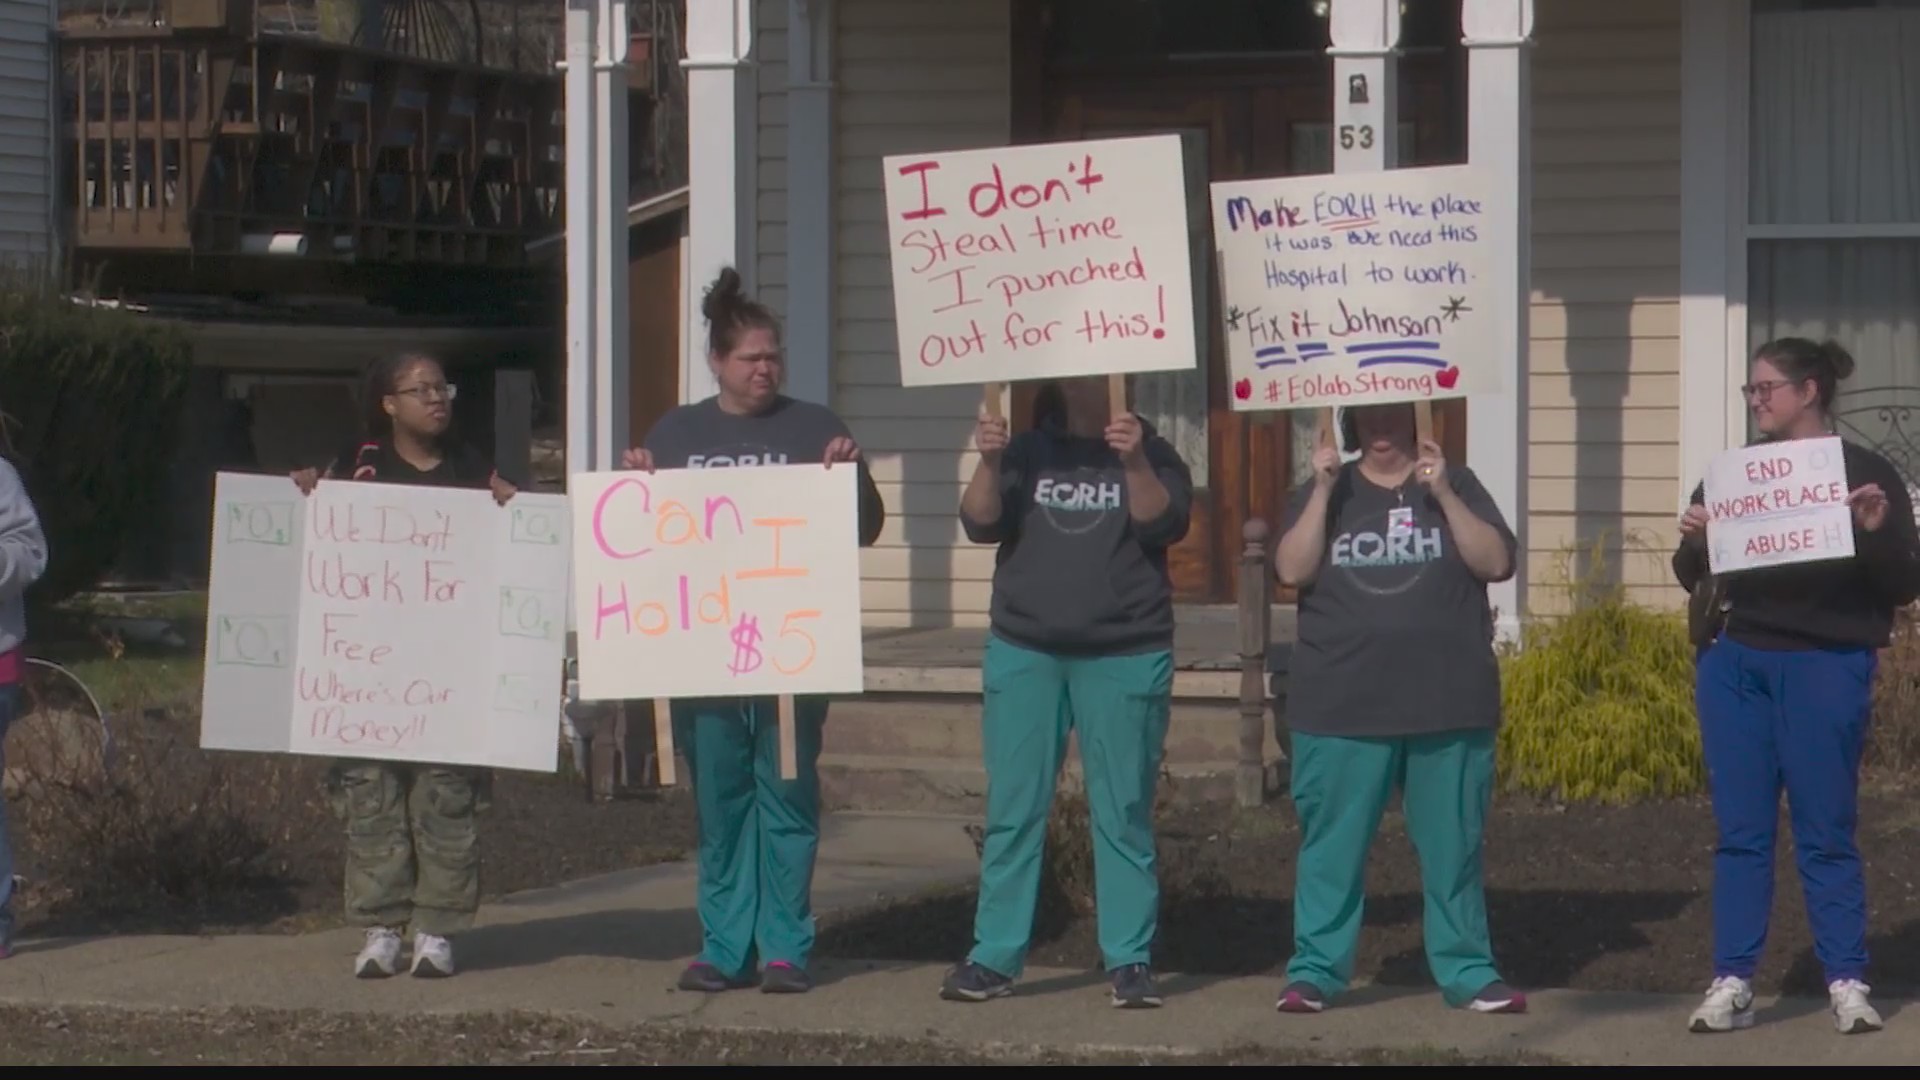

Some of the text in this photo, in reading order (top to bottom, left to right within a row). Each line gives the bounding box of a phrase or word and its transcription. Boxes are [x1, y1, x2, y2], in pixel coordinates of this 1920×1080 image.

[1340, 125, 1375, 149] 53
[899, 155, 1103, 219] I don't
[1227, 192, 1482, 231] Make EORH the place
[901, 216, 1122, 273] Steal time
[1266, 233, 1282, 250] it
[1290, 237, 1332, 250] was
[1389, 229, 1432, 247] need
[1439, 223, 1478, 243] this
[928, 246, 1147, 313] I punched
[1264, 259, 1476, 291] Hospital to work.
[1003, 312, 1062, 350] for
[1075, 285, 1166, 343] this!
[1292, 309, 1319, 338] it
[1745, 457, 1793, 481] END
[314, 499, 360, 543] We
[366, 506, 455, 551] Don't
[592, 478, 744, 559] Can
[735, 517, 809, 579] I
[1331, 526, 1442, 567] EORH
[1744, 528, 1815, 556] ABUSE
[308, 551, 404, 604] Work
[595, 574, 731, 640] Hold
[323, 613, 393, 665] Free
[300, 666, 395, 704] Where's
